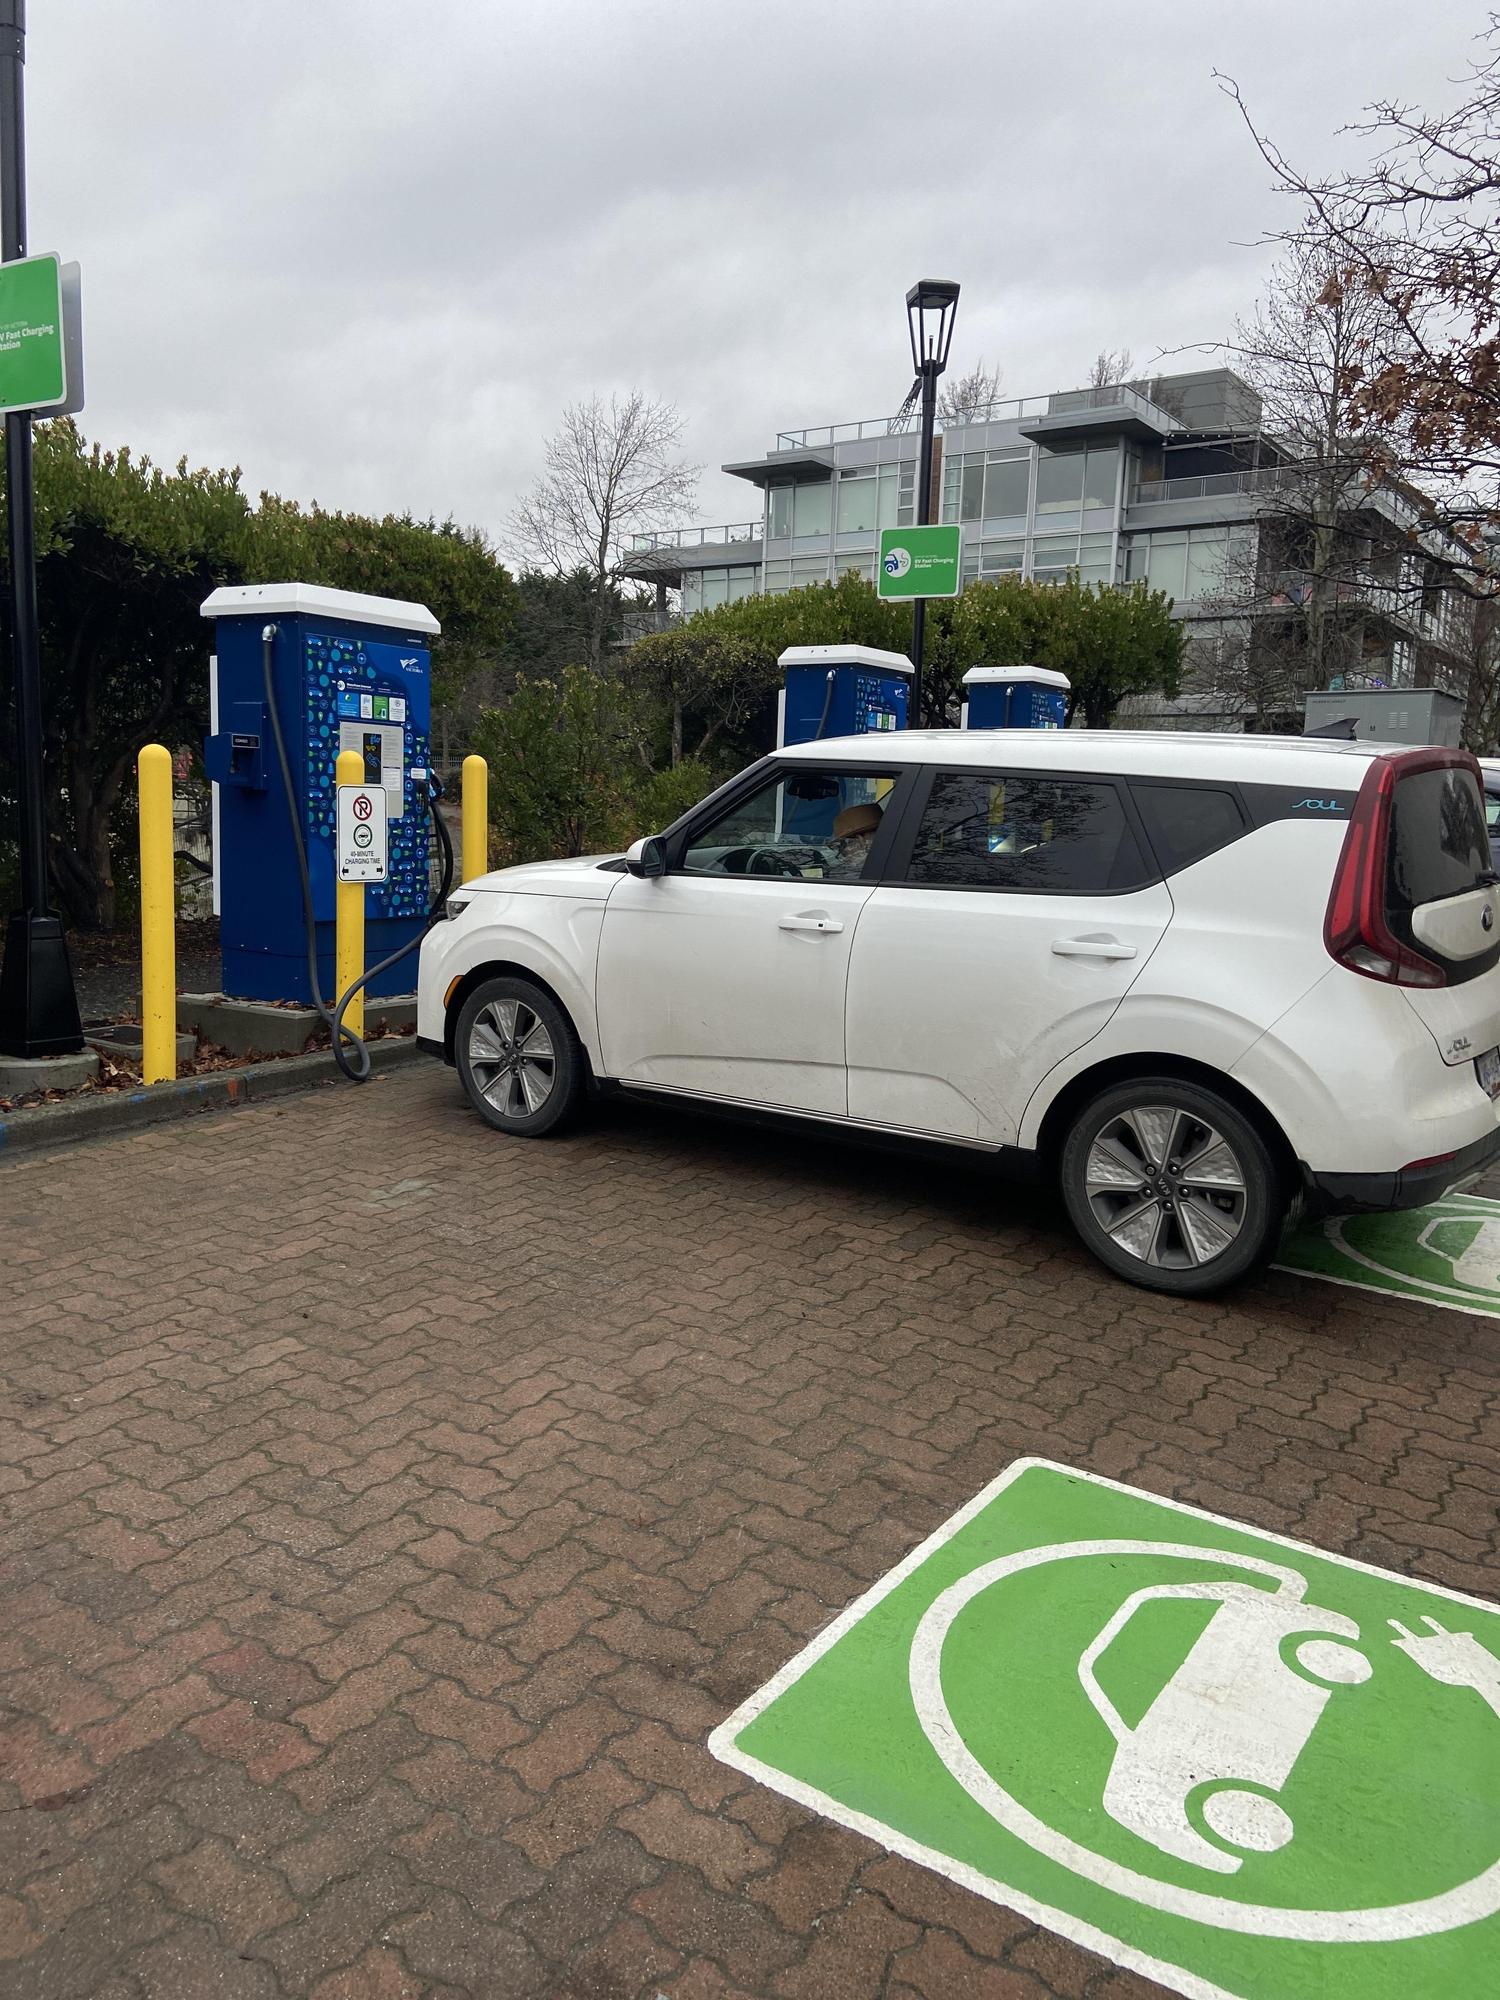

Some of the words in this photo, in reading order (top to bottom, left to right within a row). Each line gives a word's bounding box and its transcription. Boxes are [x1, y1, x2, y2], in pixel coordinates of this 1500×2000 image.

[6, 330, 21, 340] Fast
[21, 323, 54, 336] Charging
[1291, 798, 1345, 811] SOUL
[344, 857, 370, 865] CHARGING
